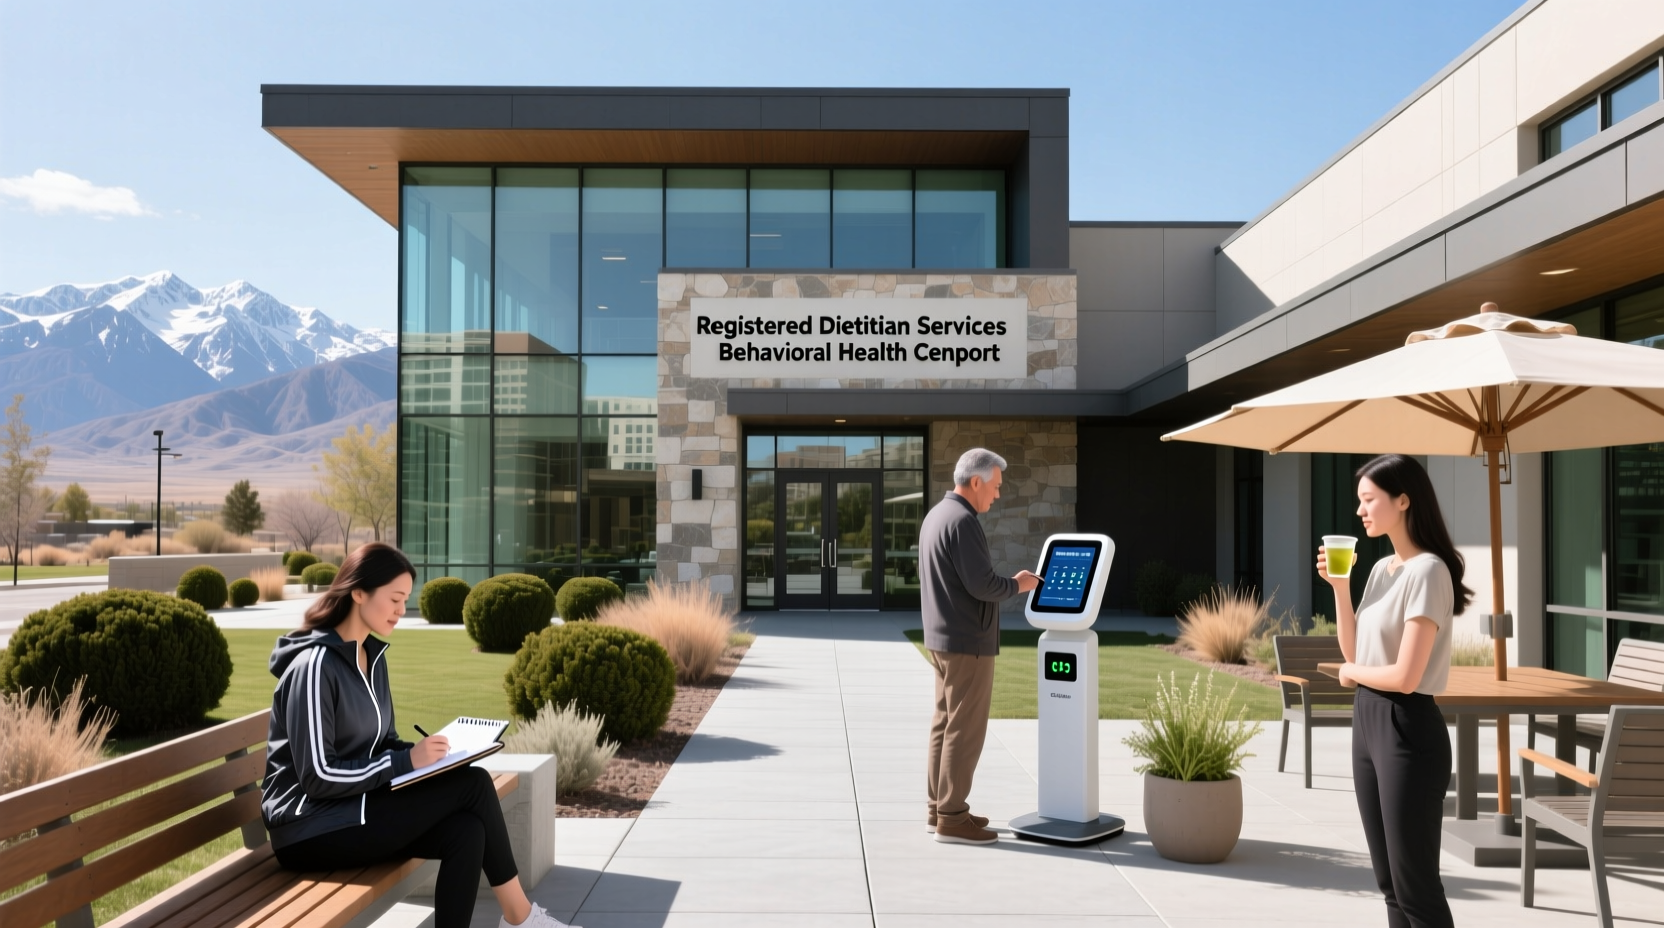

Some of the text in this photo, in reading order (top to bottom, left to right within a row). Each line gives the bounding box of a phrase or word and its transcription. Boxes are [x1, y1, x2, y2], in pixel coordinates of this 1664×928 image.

[696, 315, 1007, 339] Registered Dietitian Services
[719, 342, 1000, 367] Behavioral Health Cenport
